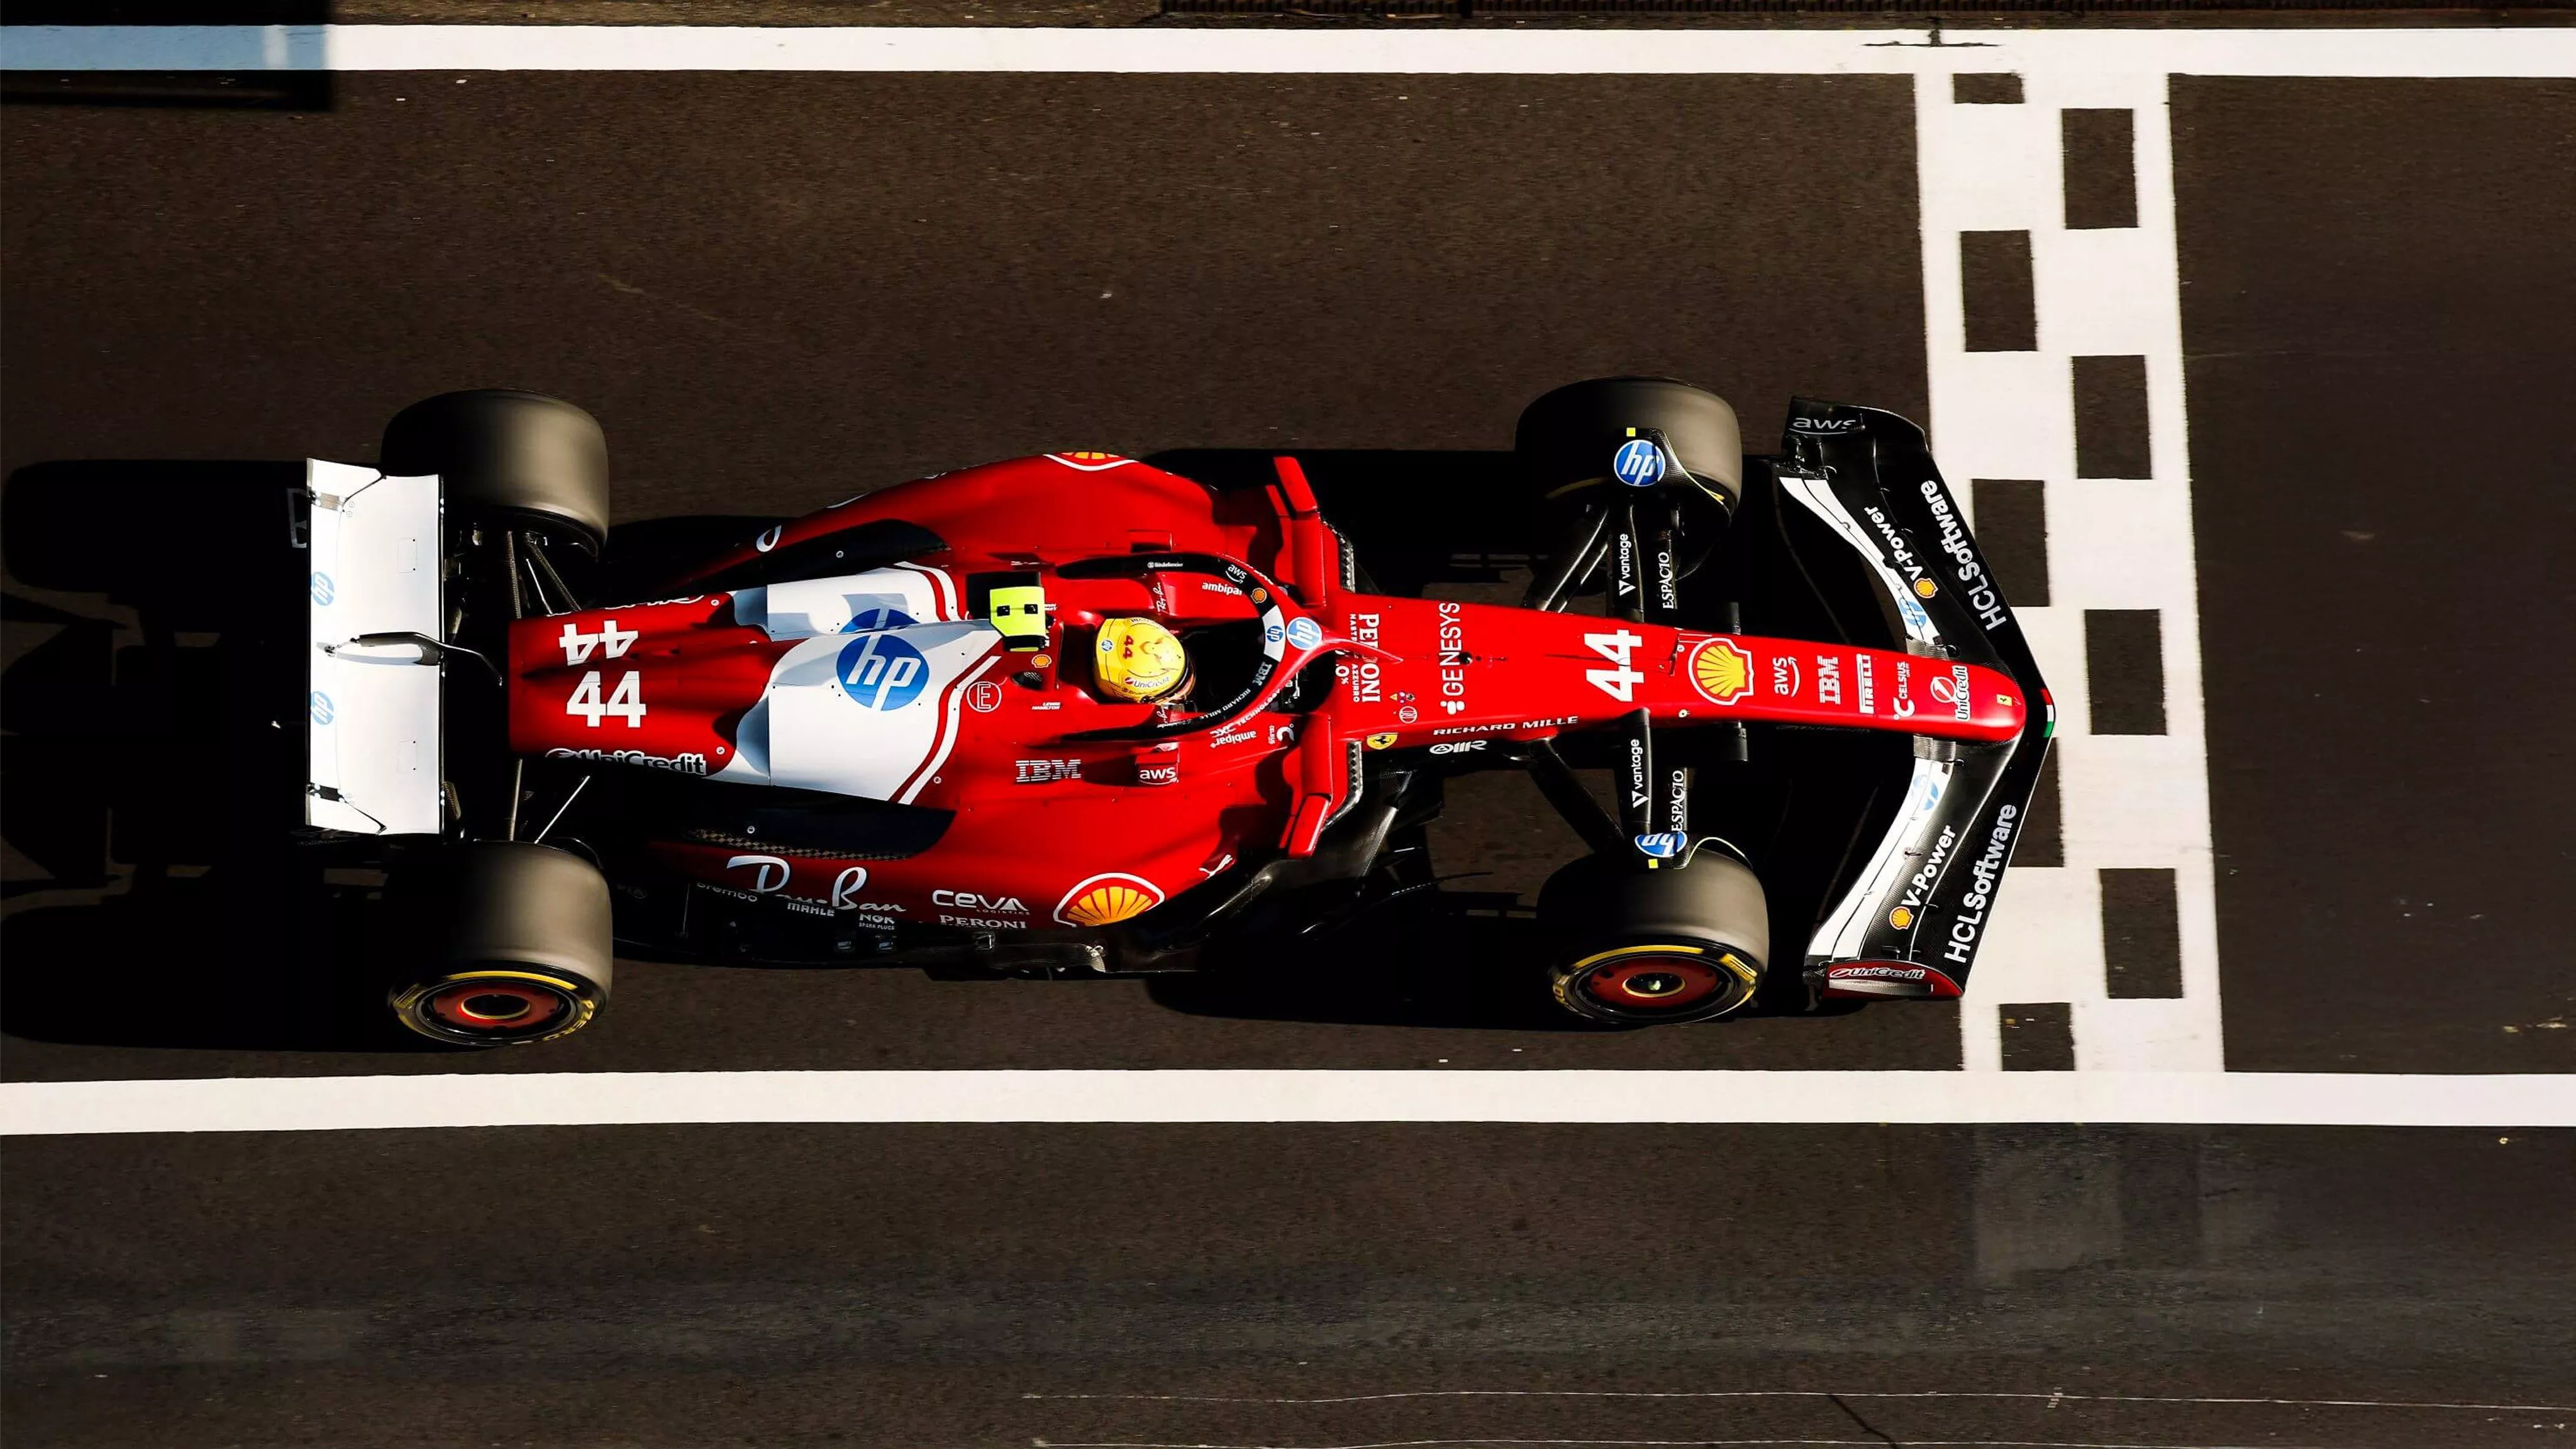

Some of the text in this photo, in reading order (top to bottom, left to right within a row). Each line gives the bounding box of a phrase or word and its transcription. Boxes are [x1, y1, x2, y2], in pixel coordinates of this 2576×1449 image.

[1621, 441, 1660, 486] hp
[1619, 534, 1631, 579] vantage
[1864, 505, 1923, 580] V-Power
[1920, 480, 2007, 630] HCLSoftware
[1228, 564, 1247, 580] aws
[558, 620, 638, 666] 44
[1123, 635, 1134, 659] 44
[1267, 626, 1283, 641] hp
[1287, 621, 1321, 648] hp
[1438, 601, 1465, 697] GENESYS
[846, 634, 921, 711] hp
[1350, 613, 1360, 702] NASTR AZZURRO
[1583, 629, 1645, 702] 44
[1772, 657, 1789, 696] aws
[1817, 655, 1841, 705] IBM
[1896, 661, 1908, 699] CELSIUS
[566, 670, 647, 728] 44
[1222, 688, 1251, 711] RICHARD
[1856, 653, 1875, 714] PIRELLI
[1952, 665, 1971, 722] UniCredit
[1214, 730, 1257, 746] ambipar
[1433, 716, 1579, 736] RICHARD MILLE
[1015, 759, 1082, 783] IBM
[1140, 767, 1177, 780] aws
[1631, 738, 1643, 789] vantage
[727, 855, 906, 912] R-Ban
[1901, 825, 1957, 907] V-Power
[1945, 804, 2018, 963] HCLSoftware
[787, 902, 835, 917] MAHLE
[859, 913, 896, 924] NGK
[939, 914, 1027, 930] PERONI
[1850, 967, 1925, 980] UniCredit
